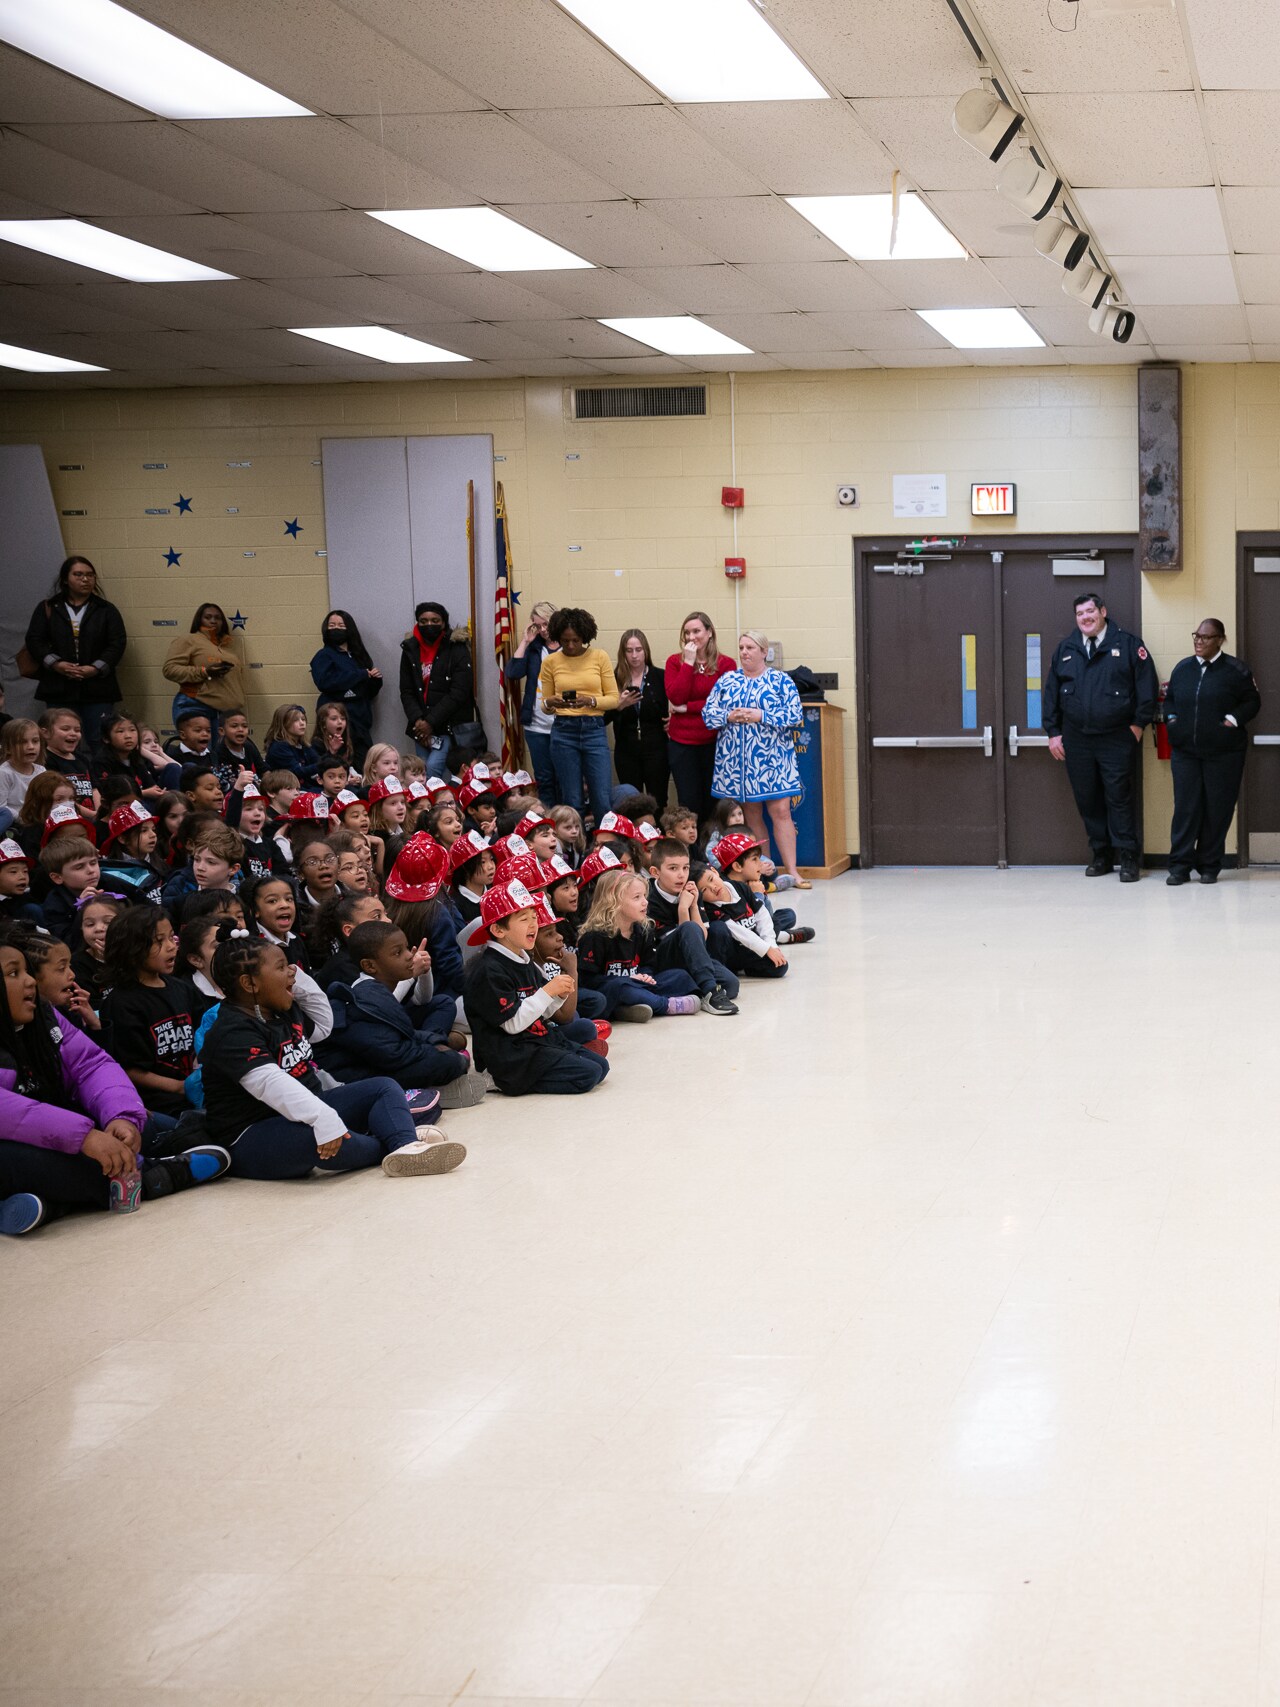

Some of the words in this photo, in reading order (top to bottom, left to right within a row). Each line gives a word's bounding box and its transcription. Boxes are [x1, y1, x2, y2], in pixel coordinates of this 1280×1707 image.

[976, 487, 1009, 512] EXIT
[154, 1020, 174, 1034] TAKE
[157, 1024, 193, 1047] CHAR
[157, 1045, 170, 1056] OF
[171, 1039, 193, 1054] SAF
